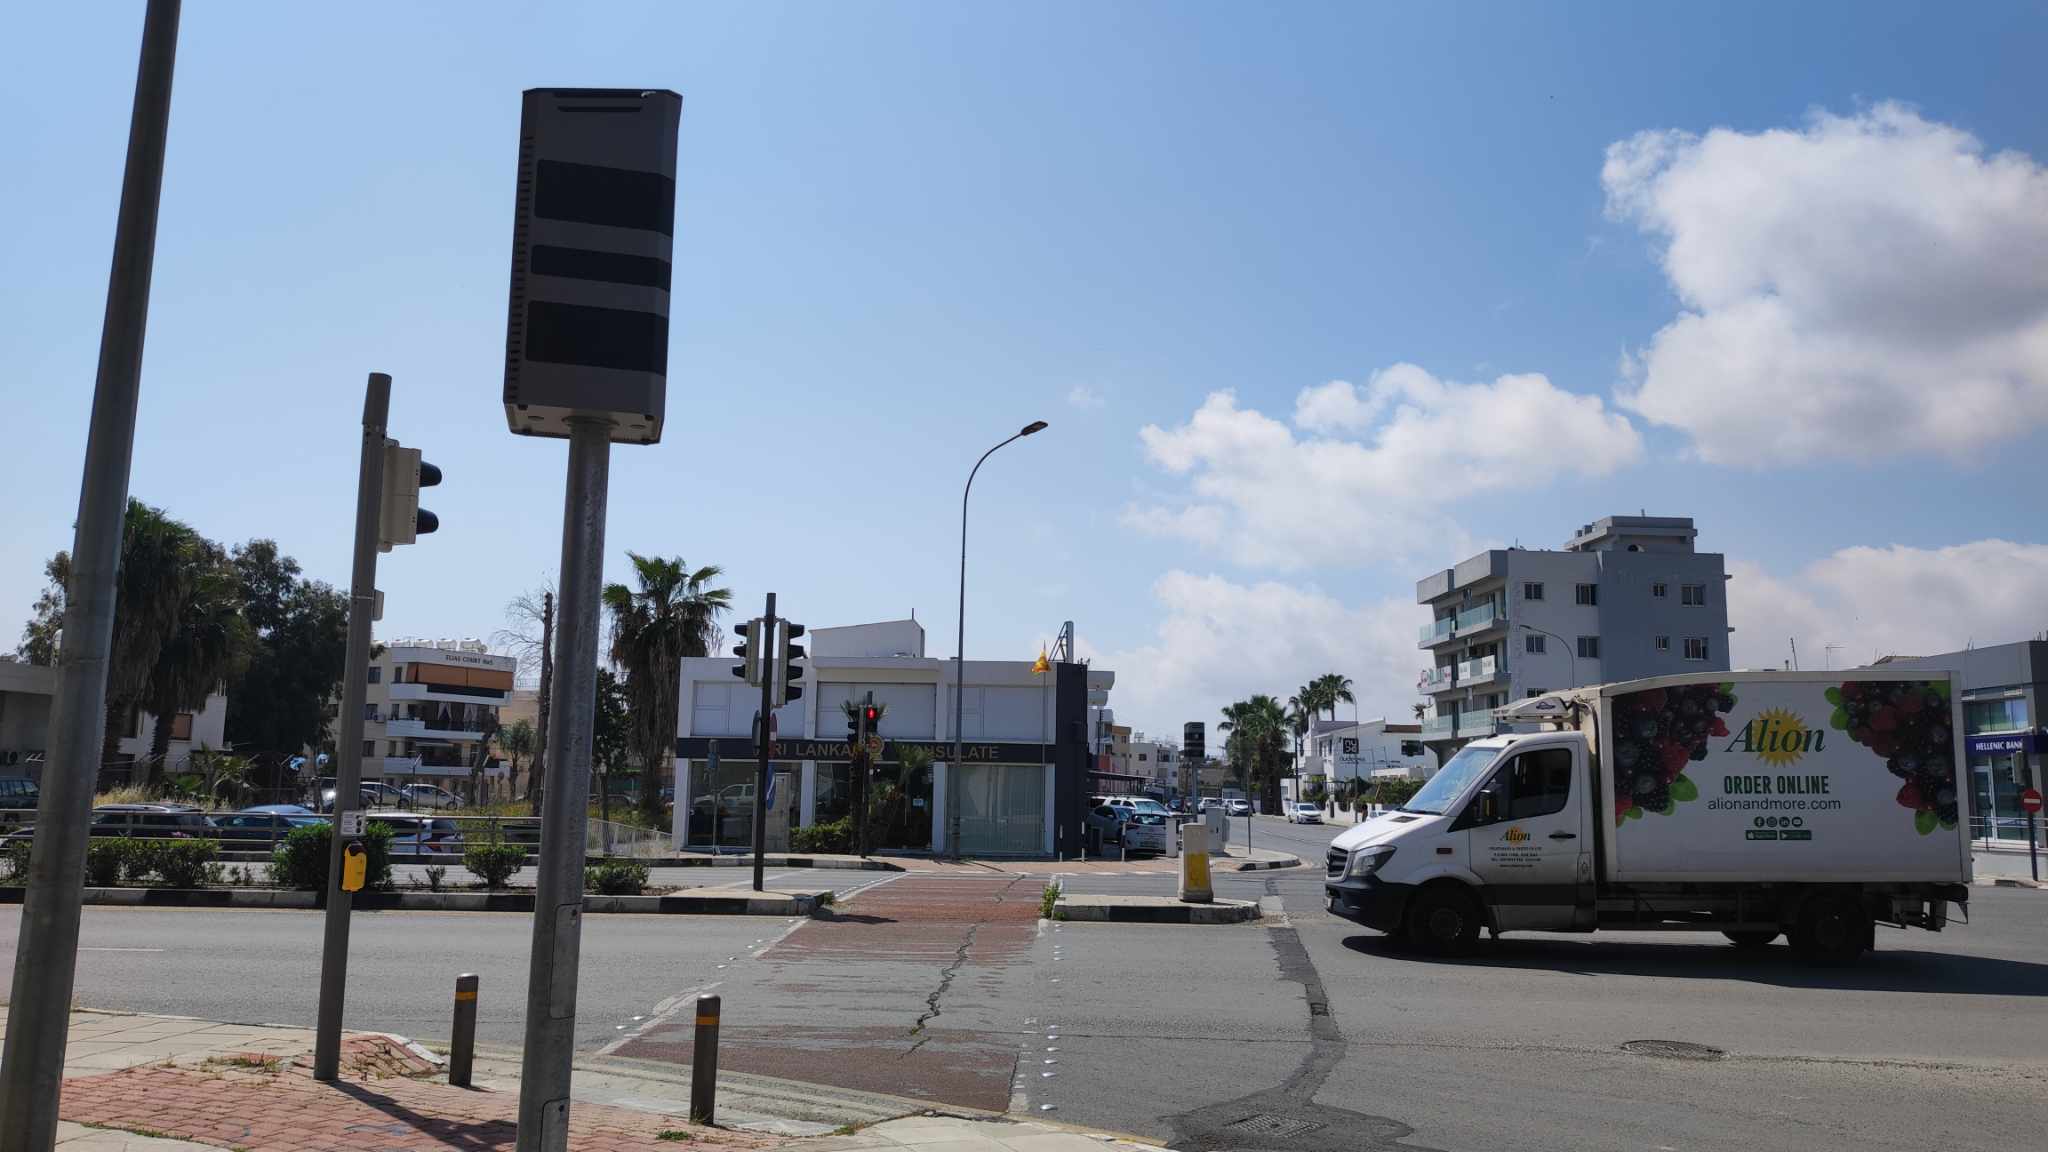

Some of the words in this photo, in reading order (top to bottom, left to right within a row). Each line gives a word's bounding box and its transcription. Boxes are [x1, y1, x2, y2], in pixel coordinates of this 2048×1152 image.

[1724, 719, 1826, 753] Alion
[1975, 741, 2005, 751] HELLENIC
[1724, 775, 1772, 795] ORDER
[1777, 775, 1830, 795] ONLINE
[1708, 797, 1841, 810] alionandmore.com
[1500, 828, 1531, 841] Alion
